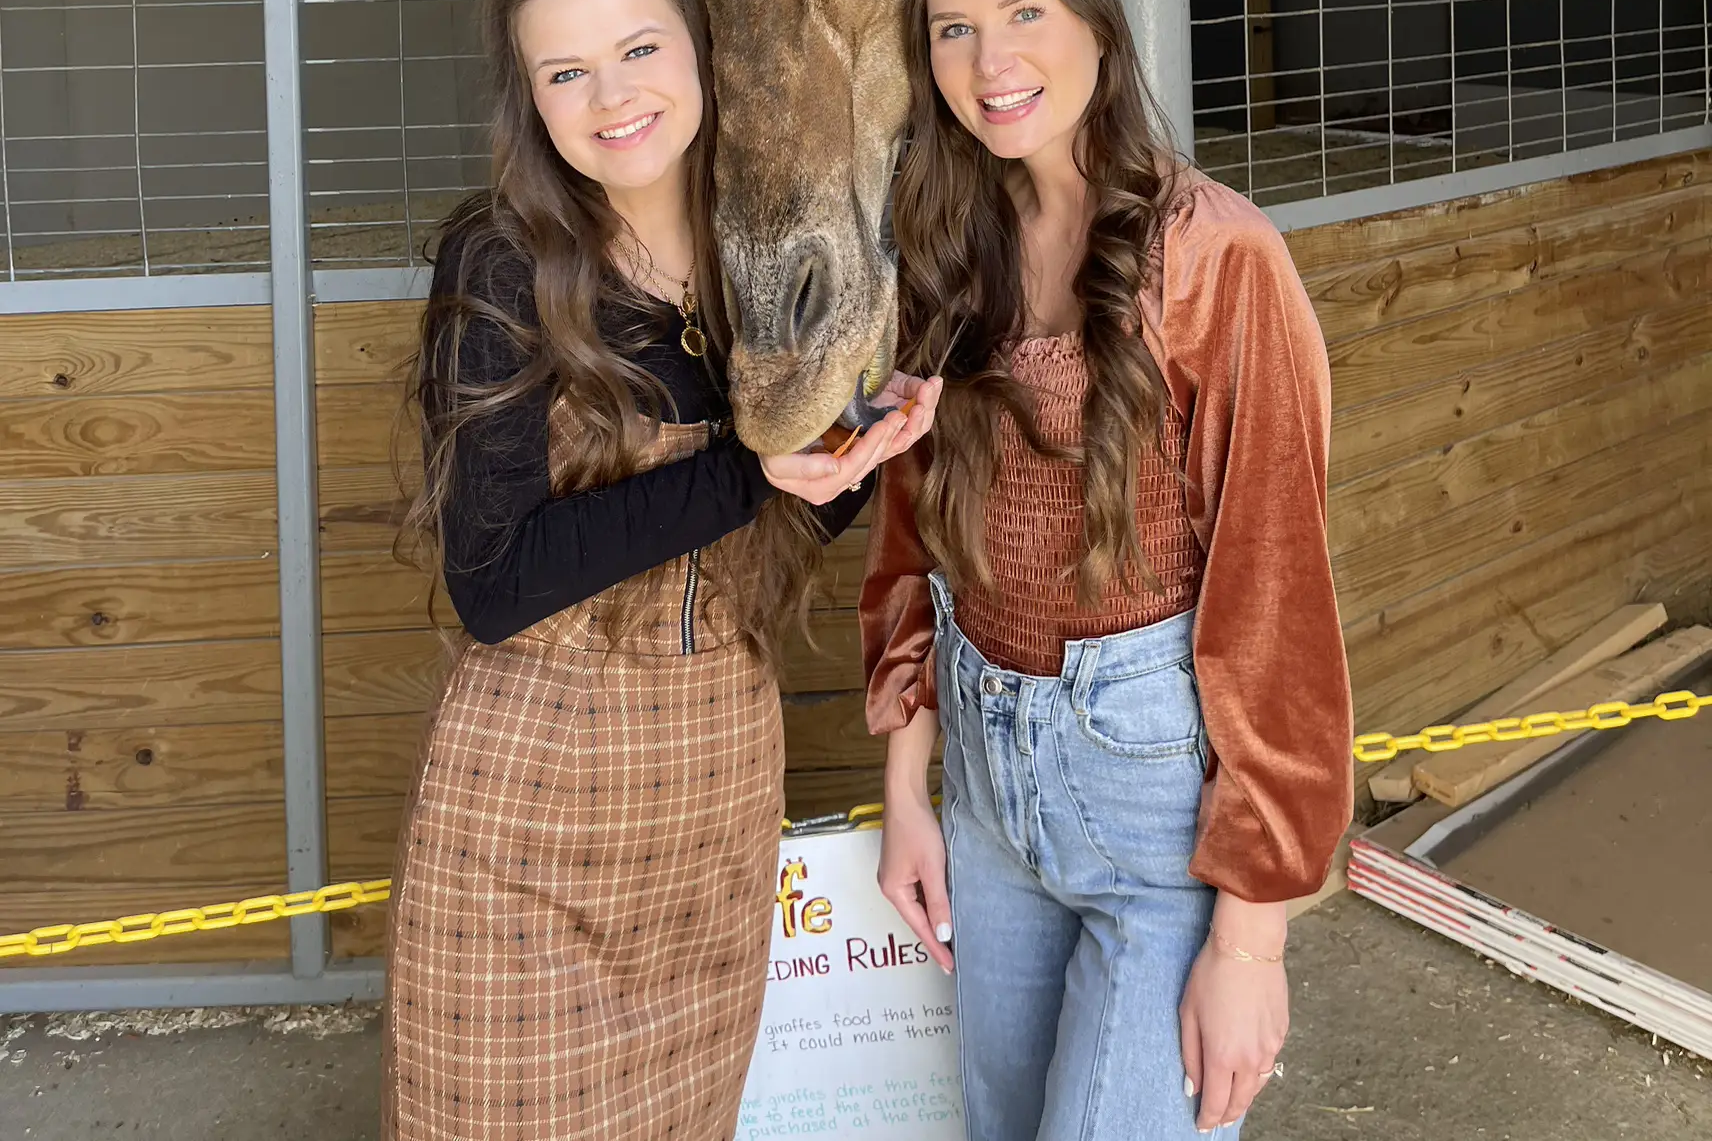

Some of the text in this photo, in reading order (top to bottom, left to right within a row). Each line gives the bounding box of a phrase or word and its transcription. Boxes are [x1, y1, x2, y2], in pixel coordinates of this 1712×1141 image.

[764, 1003, 953, 1041] giraffes food that has
[799, 1032, 843, 1051] could
[853, 1028, 895, 1044] make
[904, 1023, 951, 1039] them
[764, 1110, 783, 1123] to
[790, 1102, 826, 1119] feed
[834, 1097, 861, 1115] the
[768, 1087, 827, 1112] giraffes
[836, 1082, 874, 1099] drive
[749, 1116, 838, 1141] purchased
[852, 1112, 871, 1129] at
[881, 1111, 909, 1126] the
